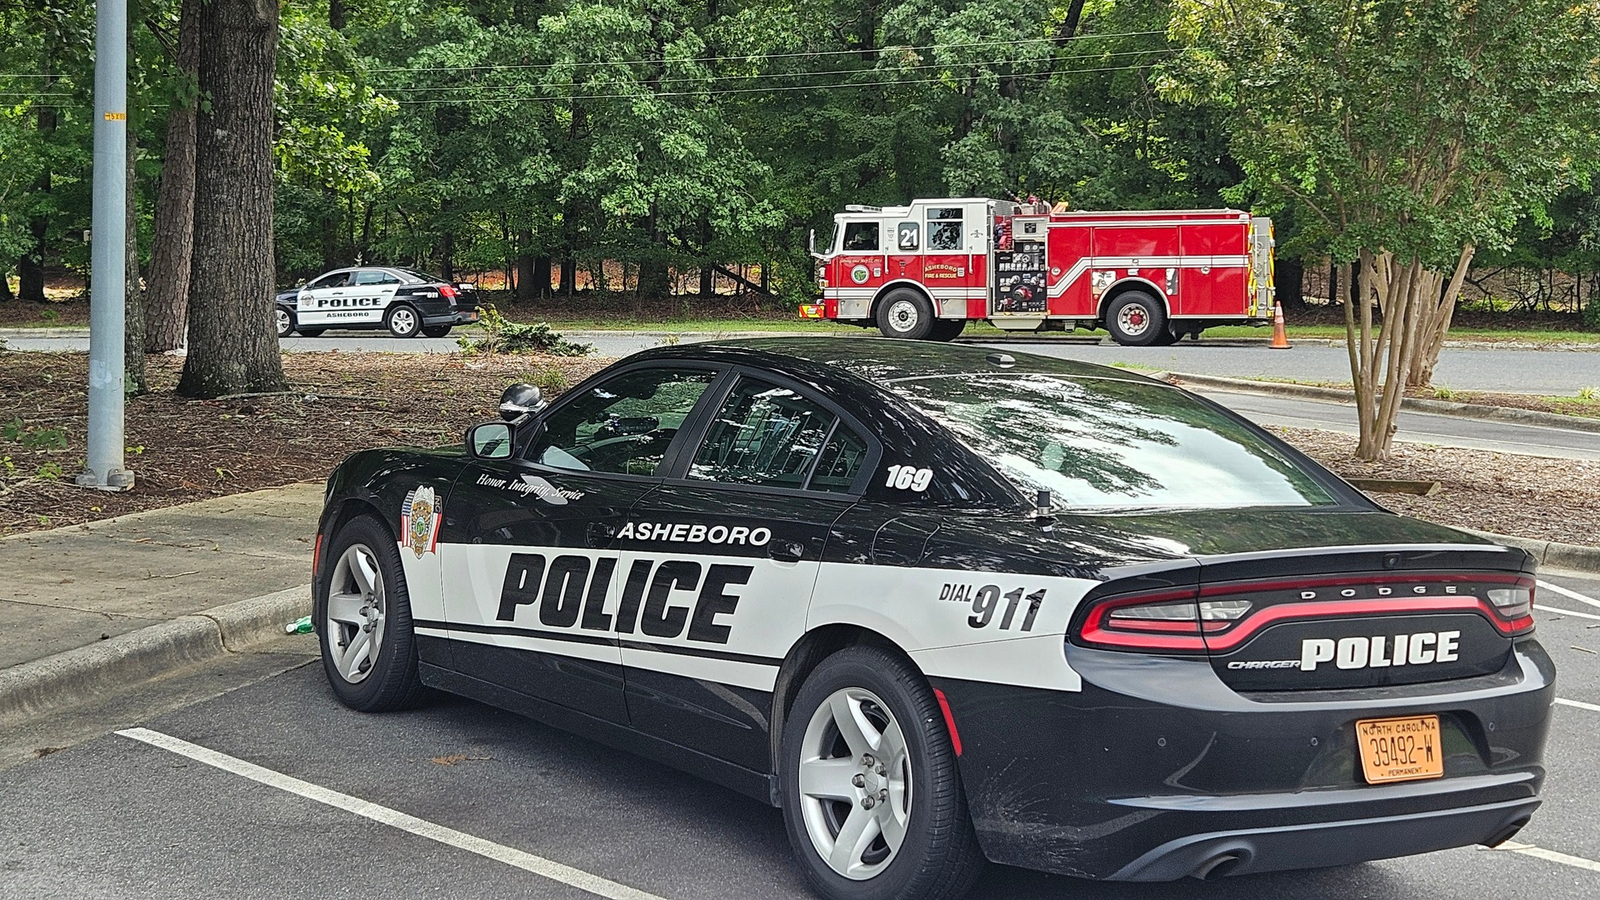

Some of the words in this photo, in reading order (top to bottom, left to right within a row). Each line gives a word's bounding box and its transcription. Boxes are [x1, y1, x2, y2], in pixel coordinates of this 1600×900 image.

[900, 228, 918, 247] 21
[924, 264, 957, 273] ASHEBORO
[317, 297, 382, 308] POLICE
[476, 473, 507, 490] Honor,
[507, 479, 550, 500] Integrity,
[551, 486, 585, 500] Service
[885, 464, 933, 492] 169
[434, 497, 441, 513] NC
[616, 522, 772, 546] ASHEBORO
[496, 552, 754, 645] POLICE
[1301, 585, 1457, 600] DODGE
[938, 583, 973, 602] DIAL
[967, 584, 1047, 632] 911
[1227, 660, 1301, 670] CHARGER
[1300, 630, 1461, 672] POLICE
[1362, 725, 1391, 735] NORTH
[1396, 721, 1435, 733] CAROLINA
[1370, 734, 1433, 766] 39492-W
[1388, 767, 1422, 776] PERMANENT
